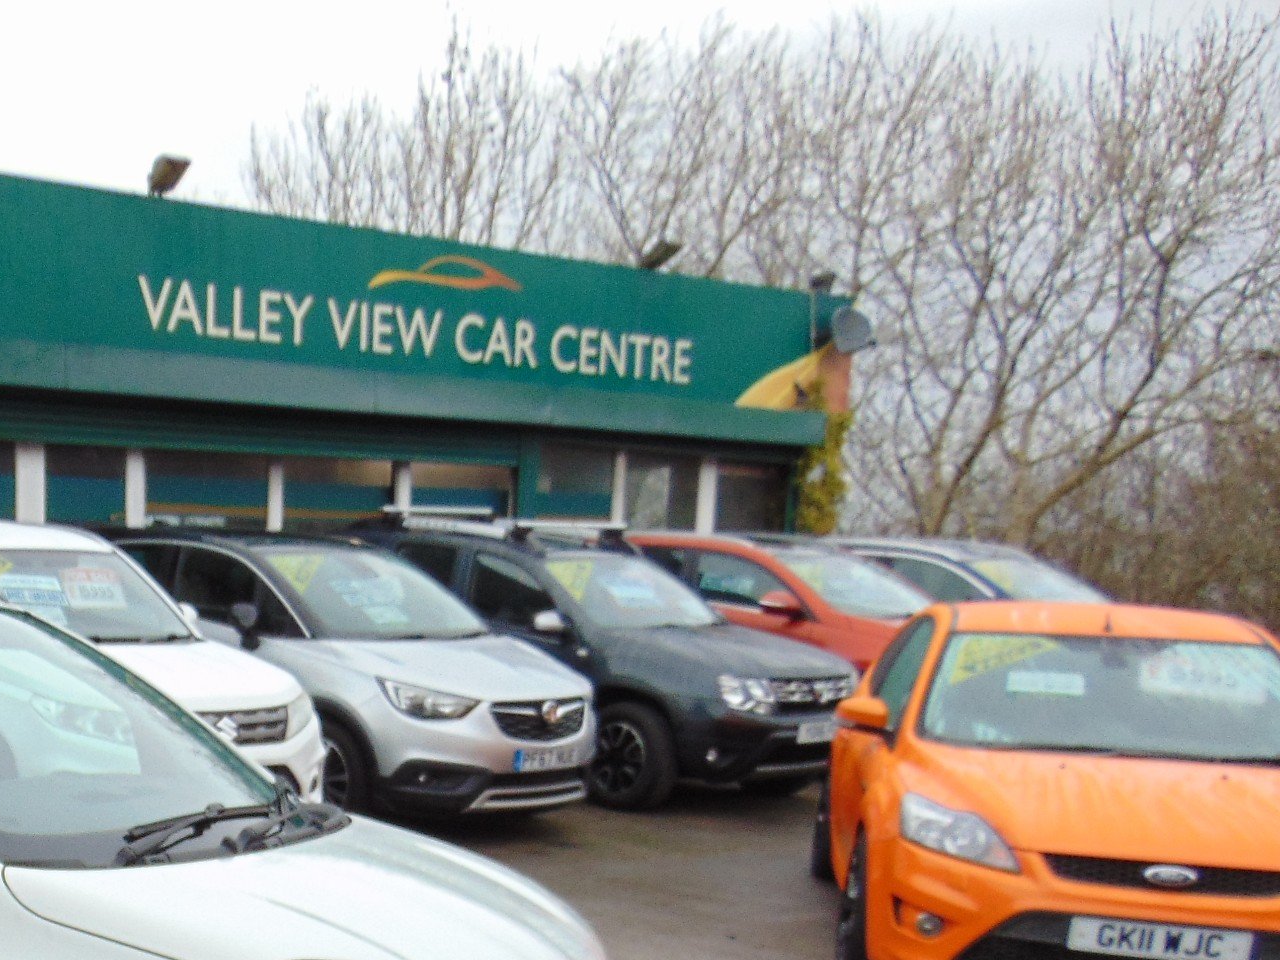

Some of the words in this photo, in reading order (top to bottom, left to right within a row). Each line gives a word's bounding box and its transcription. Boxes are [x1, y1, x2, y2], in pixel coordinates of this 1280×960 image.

[138, 275, 314, 345] VALLEY
[327, 298, 443, 356] VIEW
[454, 313, 537, 367] CAR
[551, 325, 692, 384] CENTRE
[1097, 923, 1155, 952] GK11
[1163, 930, 1224, 958] WJC
